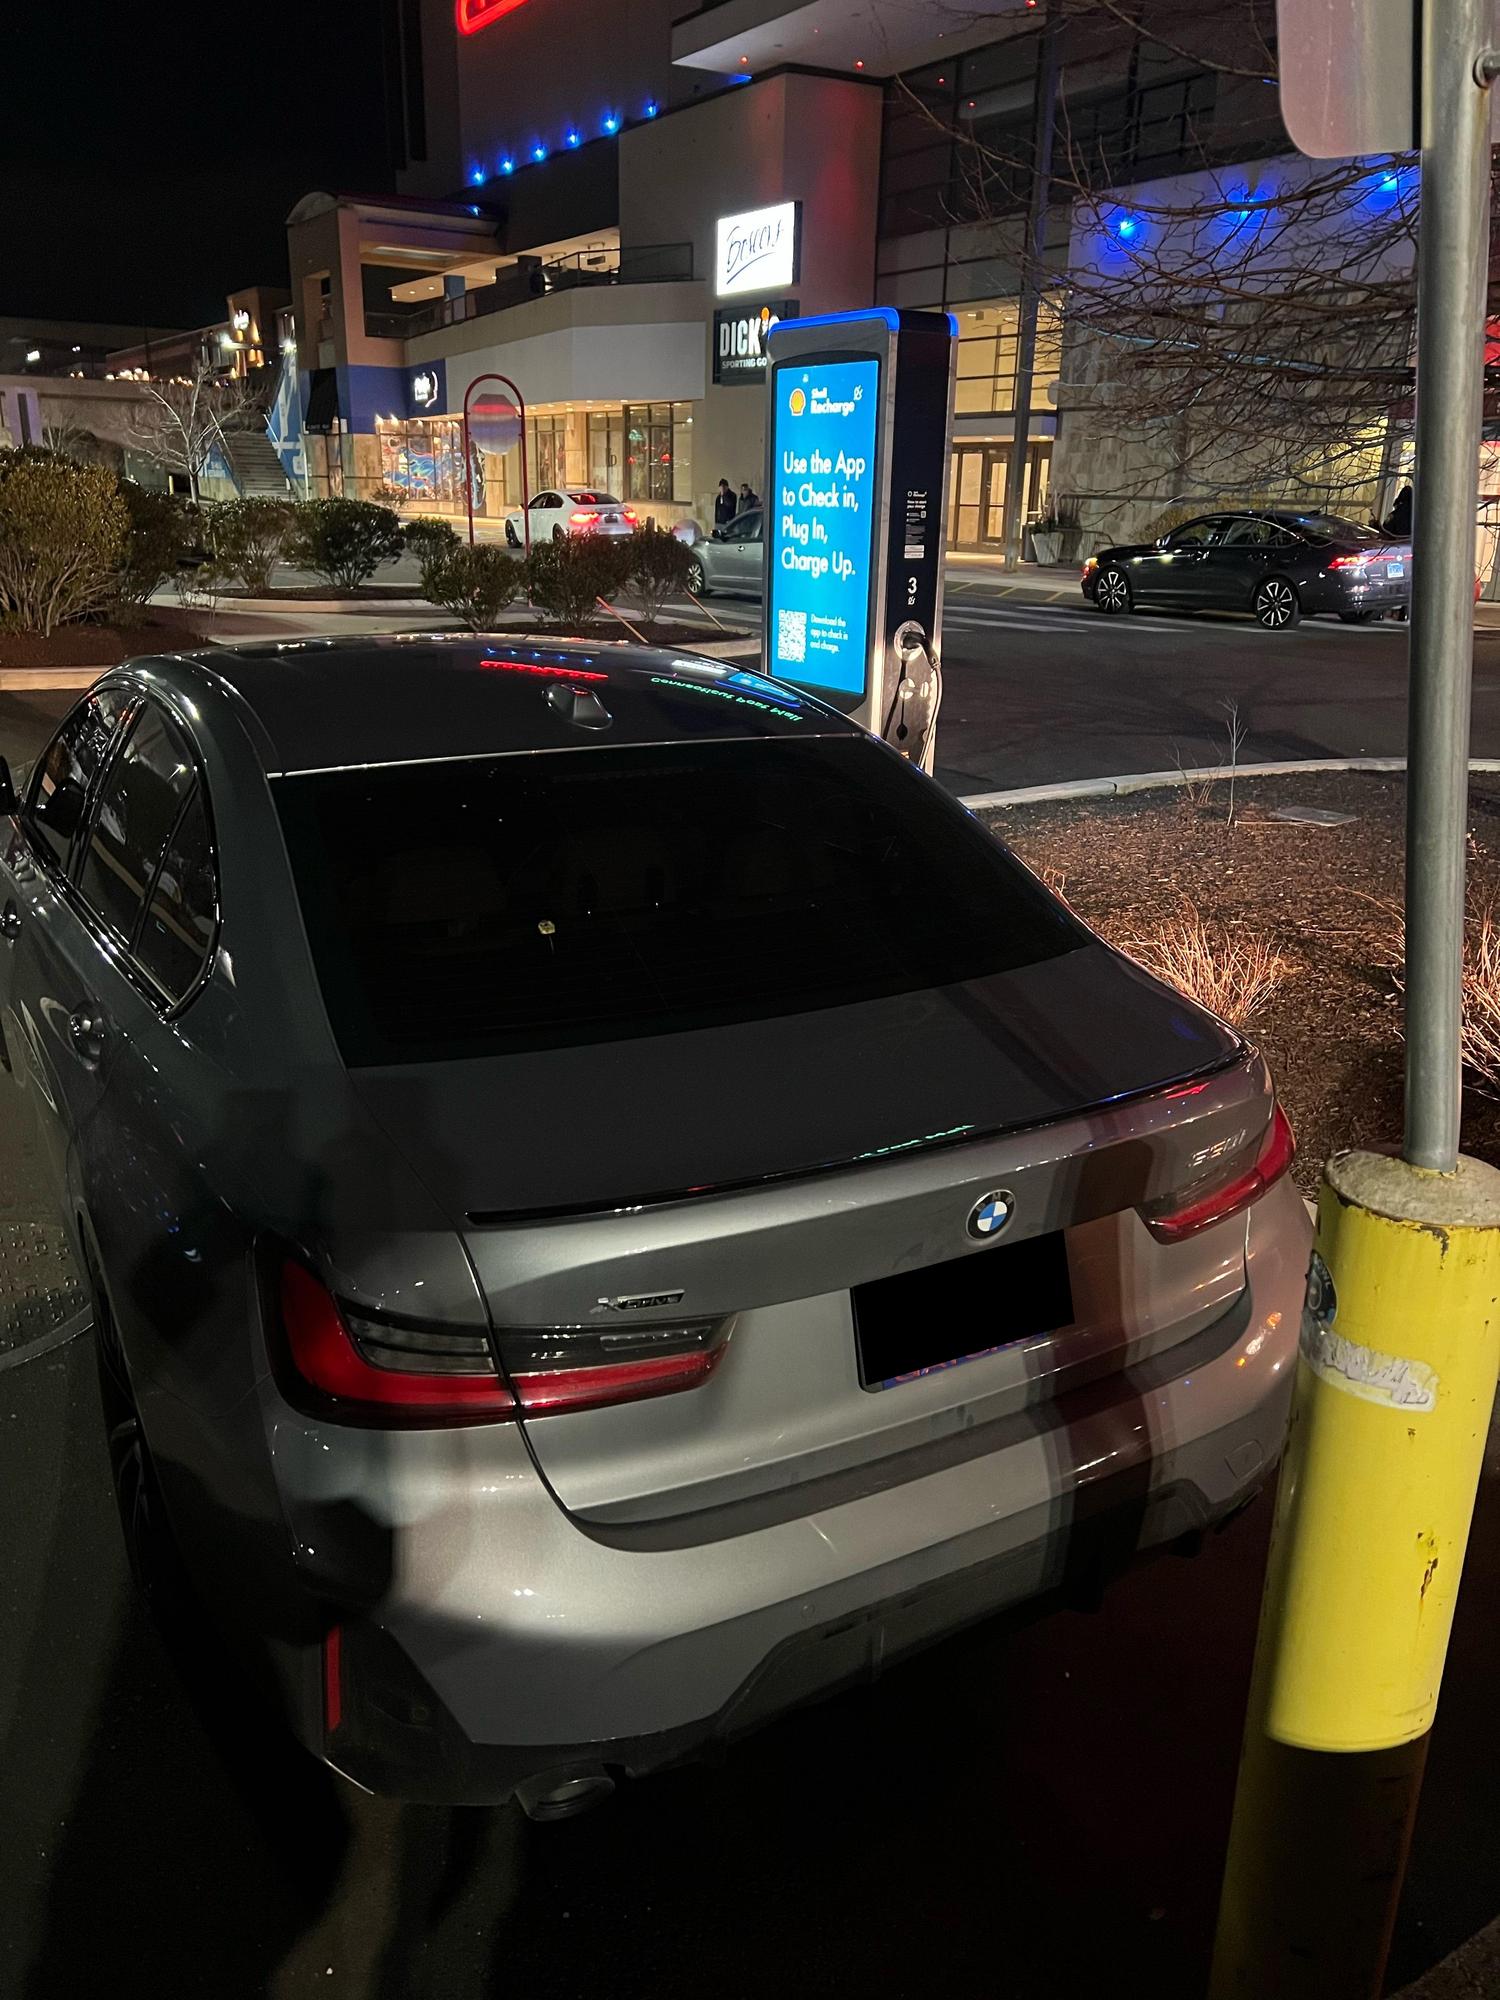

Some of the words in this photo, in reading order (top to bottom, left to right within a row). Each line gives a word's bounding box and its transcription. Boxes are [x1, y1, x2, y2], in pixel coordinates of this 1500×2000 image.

[720, 307, 780, 357] DICK'
[722, 358, 756, 369] SPORTING
[811, 398, 855, 416] Recharge
[783, 450, 808, 474] Use
[811, 448, 832, 474] the
[834, 449, 866, 481] App
[782, 486, 796, 507] to
[798, 482, 840, 508] Check
[842, 484, 859, 513] in,
[782, 513, 810, 546] Plug
[812, 516, 828, 545] In,
[781, 545, 829, 579] Charge
[832, 550, 856, 582] Up.
[907, 576, 917, 594] 3
